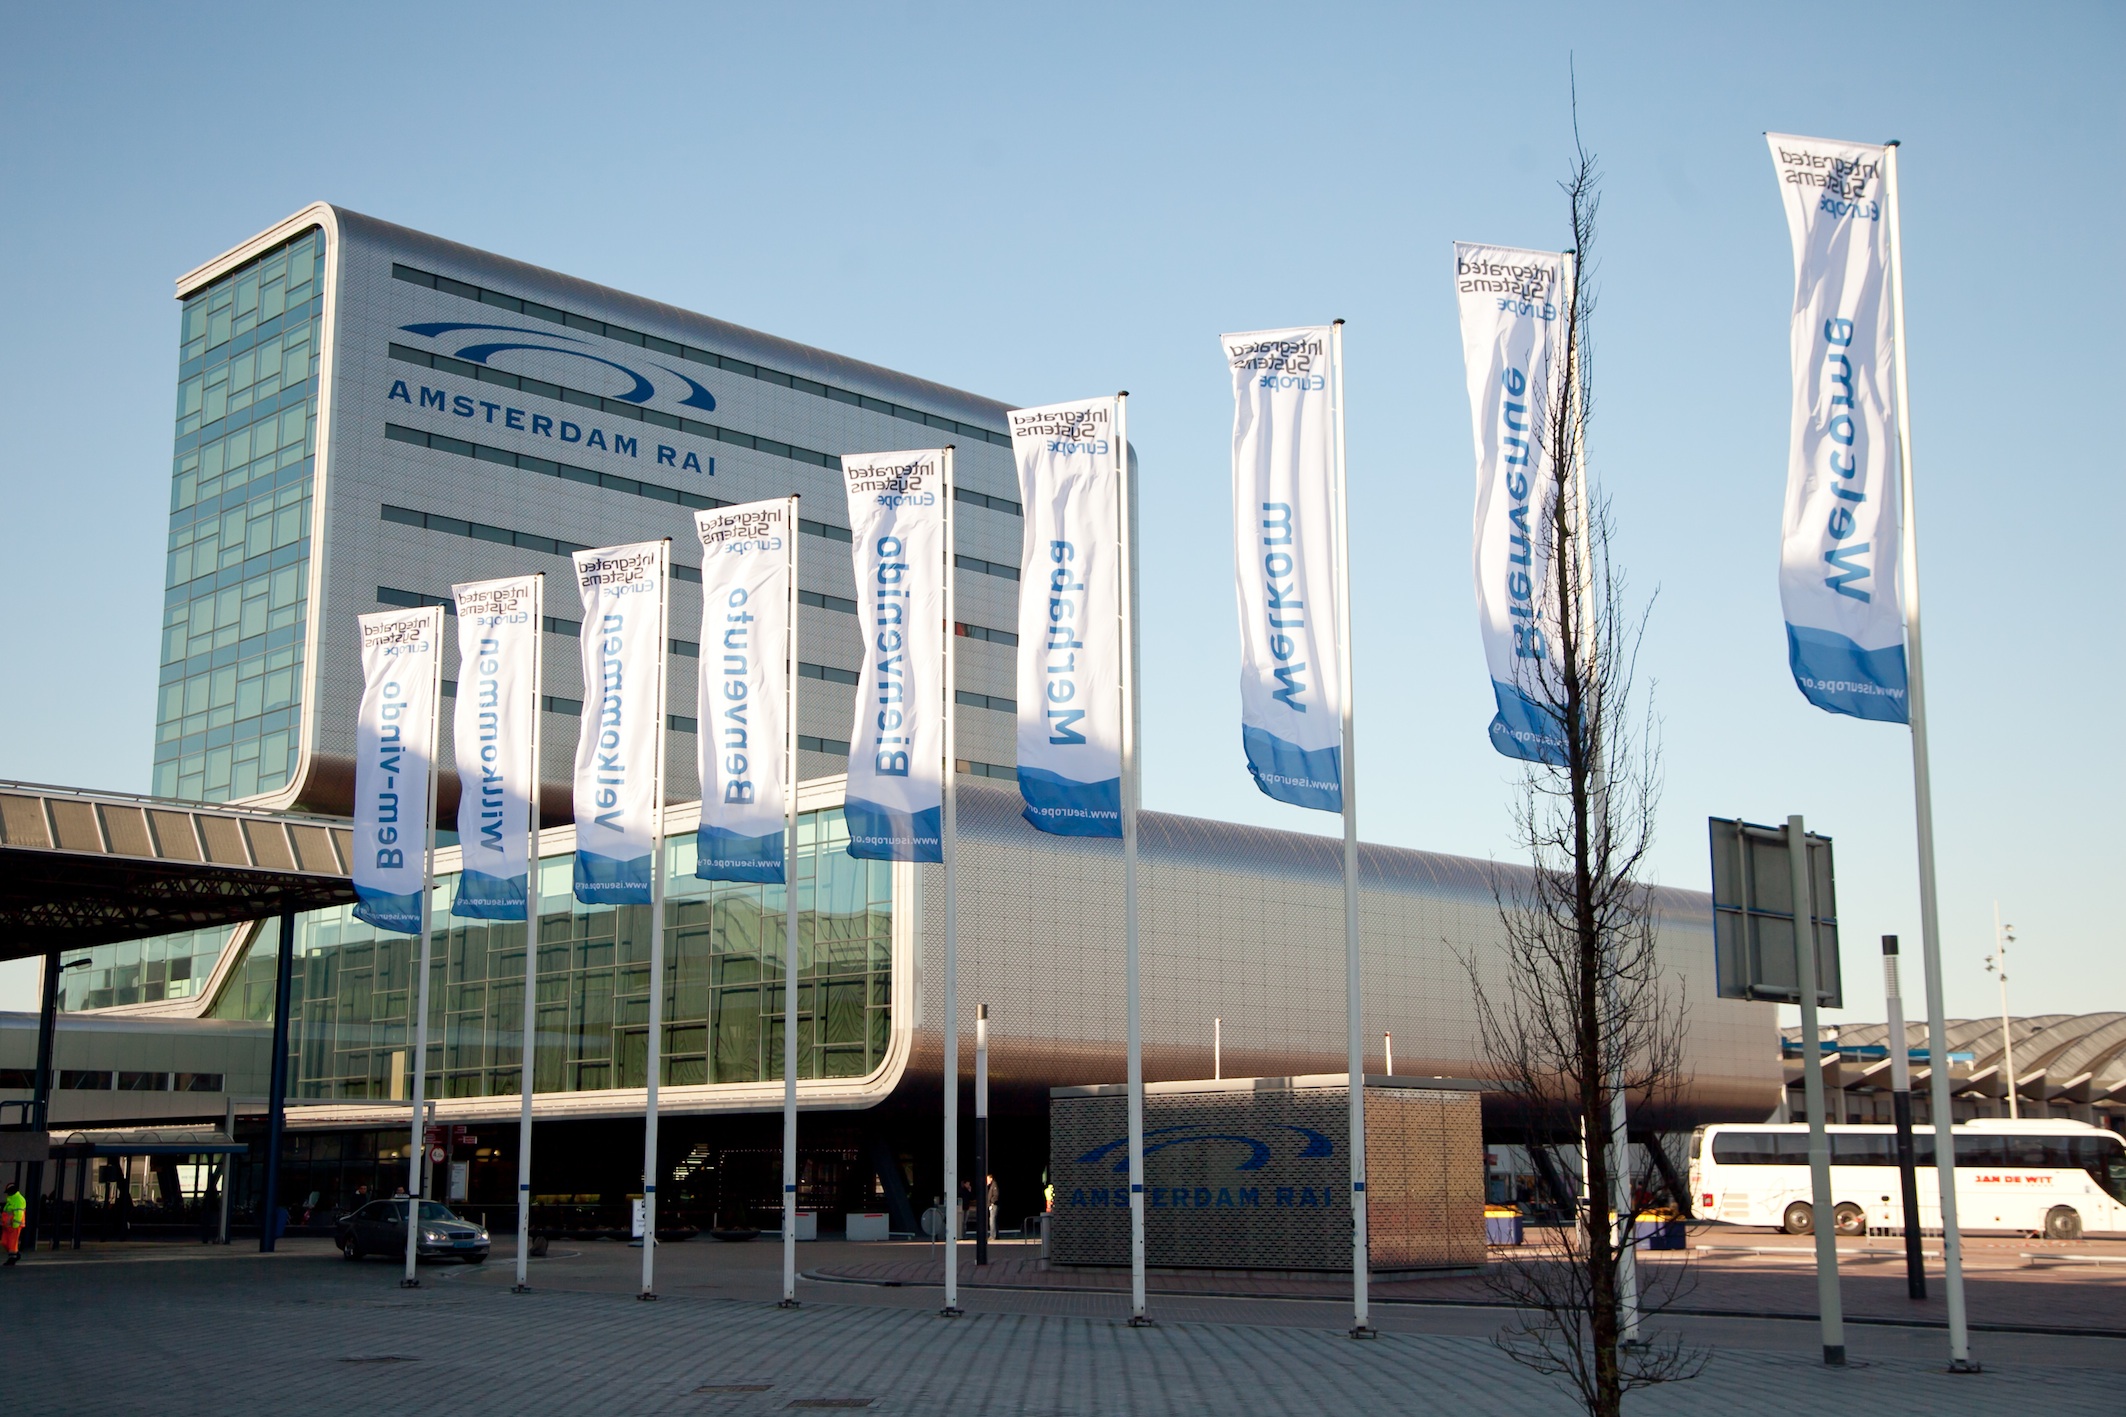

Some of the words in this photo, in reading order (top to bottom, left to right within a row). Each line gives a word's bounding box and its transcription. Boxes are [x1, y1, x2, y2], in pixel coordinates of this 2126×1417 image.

[388, 380, 638, 458] AMSTERDAM
[657, 444, 716, 476] RAI
[1071, 1187, 1260, 1208] AMSERDAM
[1276, 1187, 1333, 1208] RAI
